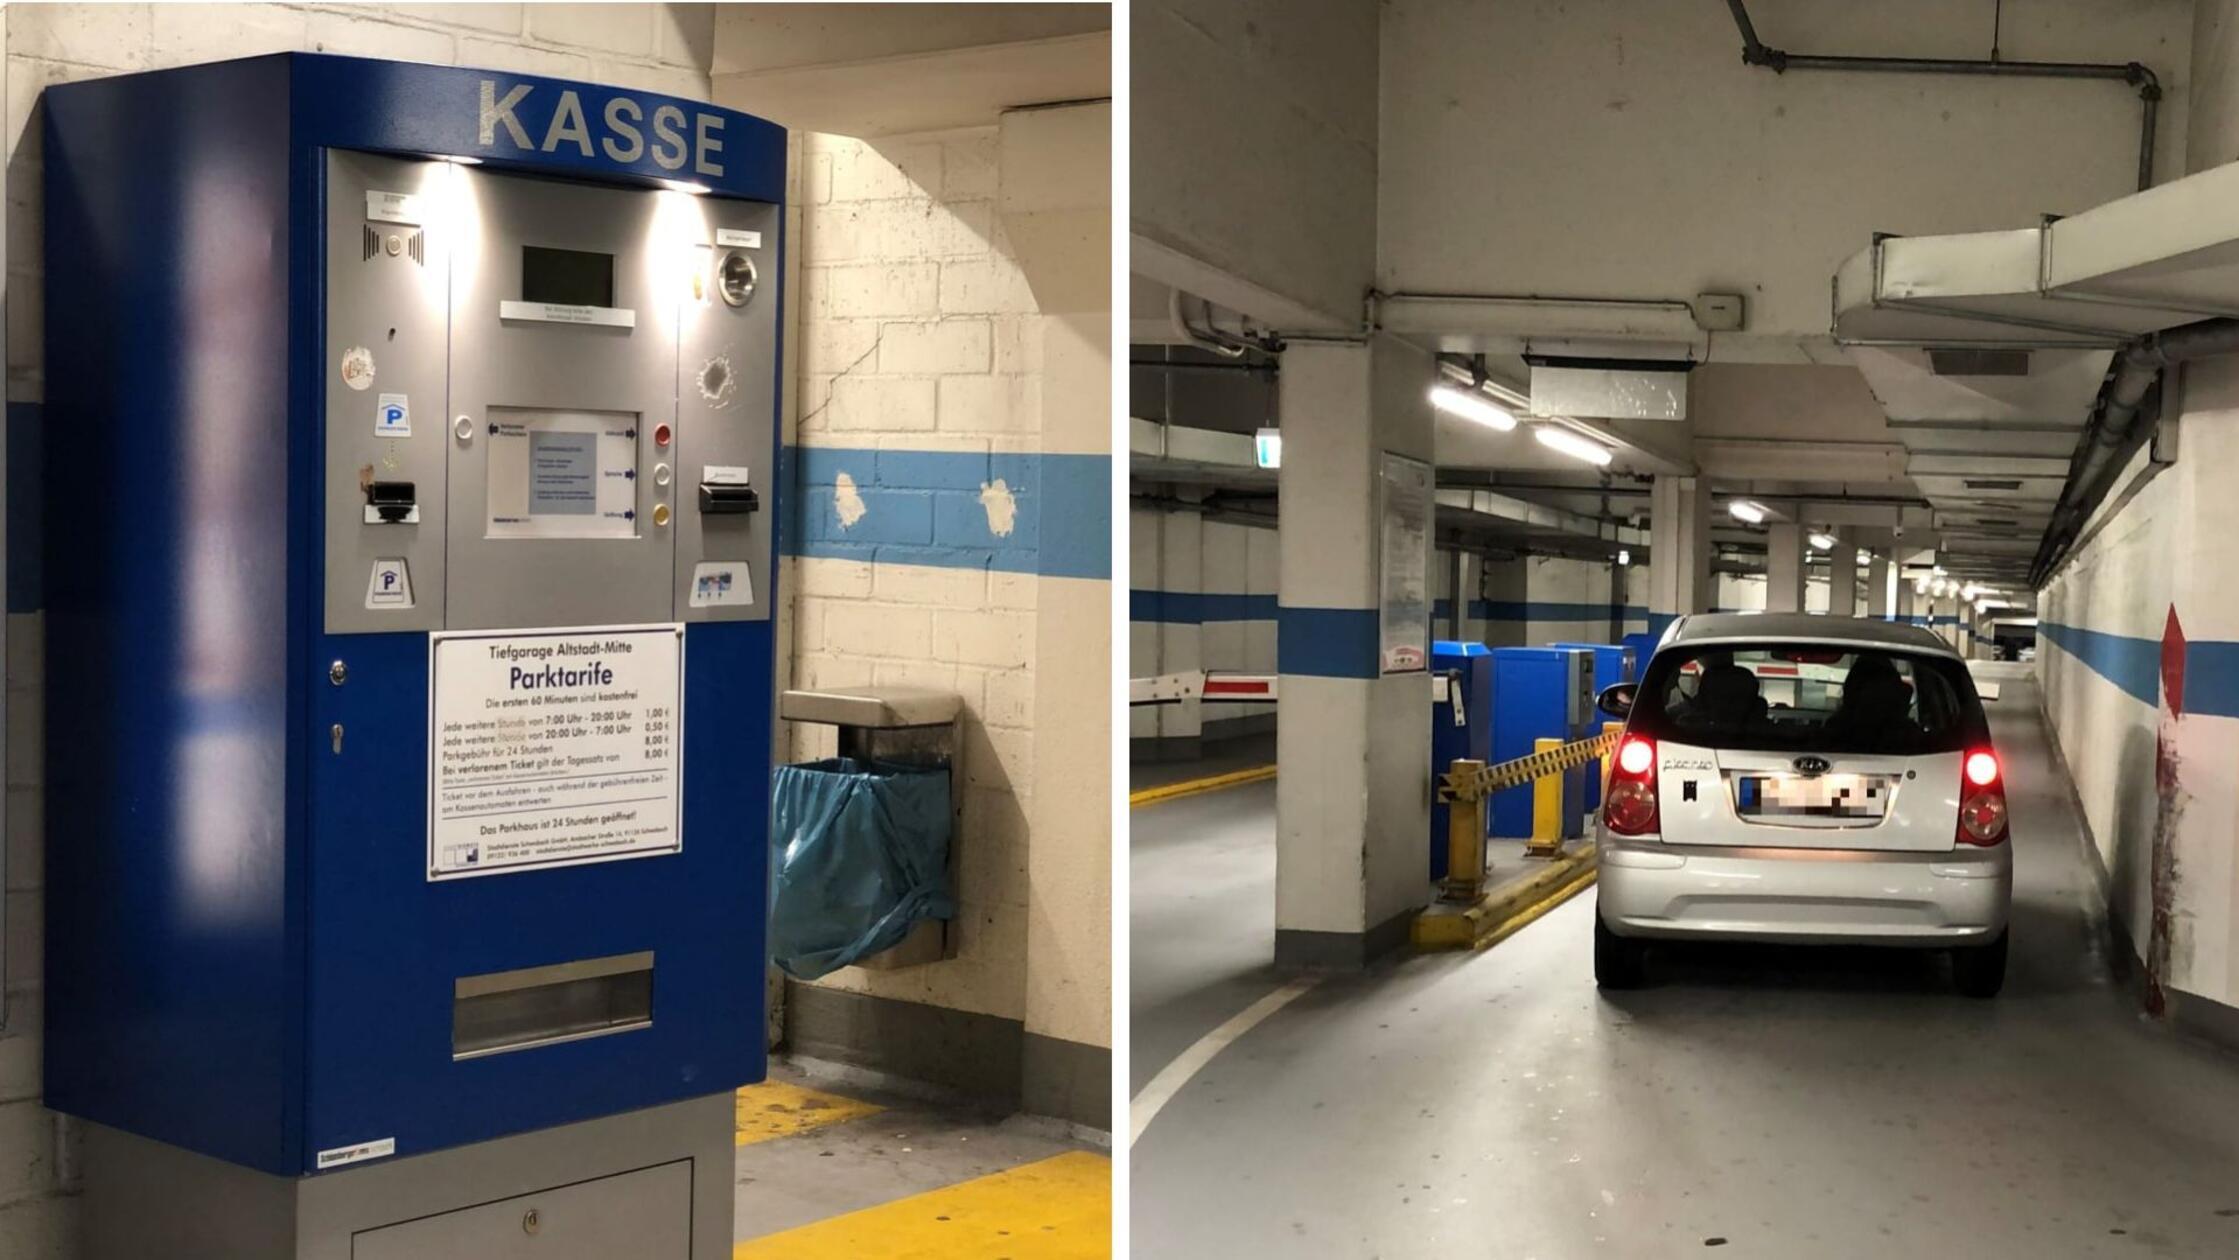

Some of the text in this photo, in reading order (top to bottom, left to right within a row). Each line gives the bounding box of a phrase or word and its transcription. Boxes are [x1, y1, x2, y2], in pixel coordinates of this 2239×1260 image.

[478, 80, 725, 177] KASSE
[489, 640, 633, 661] Tiefgarage Altstadt-Mitte
[510, 661, 613, 690] Parktarife
[485, 689, 638, 709] Die ersten 60 Minuten sind kostenfrei
[443, 721, 462, 732] Jede
[465, 721, 496, 730] weitere
[528, 718, 543, 727] von
[546, 714, 565, 725] 7:00
[567, 713, 582, 724] Uhr
[591, 711, 615, 722] 20:00
[616, 710, 632, 721] Uhr
[646, 708, 662, 719] 1,00
[443, 735, 462, 747] Jede
[465, 735, 496, 745] weitere
[528, 732, 543, 740] von
[545, 728, 569, 739] 20:00
[571, 727, 588, 738] Uhr
[596, 725, 615, 736] 7:00
[616, 724, 632, 734] Uhr
[645, 722, 663, 733] 0,50
[442, 750, 491, 762] Parkgebühr
[493, 747, 505, 758] für
[507, 746, 518, 756] 24
[520, 744, 553, 755] Stunden
[645, 735, 662, 747] 8,00
[442, 765, 456, 775] Bei
[458, 762, 507, 773] verlorenem
[510, 759, 535, 770] Ticket
[536, 759, 549, 770] gilt
[551, 757, 565, 767] der
[567, 755, 604, 767] Tagessatz
[606, 754, 621, 762] von
[645, 748, 662, 760] 8,00
[442, 792, 463, 801] Ticket
[465, 791, 476, 799] vor
[478, 790, 494, 798] dem
[496, 787, 531, 797] Ausfahren
[538, 784, 554, 793] auch
[556, 781, 585, 791] während
[587, 780, 599, 789] der
[651, 774, 664, 783] Zeit
[442, 797, 552, 814] am Kassenautomaten entwerten
[480, 811, 637, 836] Das Parkhaus ist 24 Stunden geöffnet!
